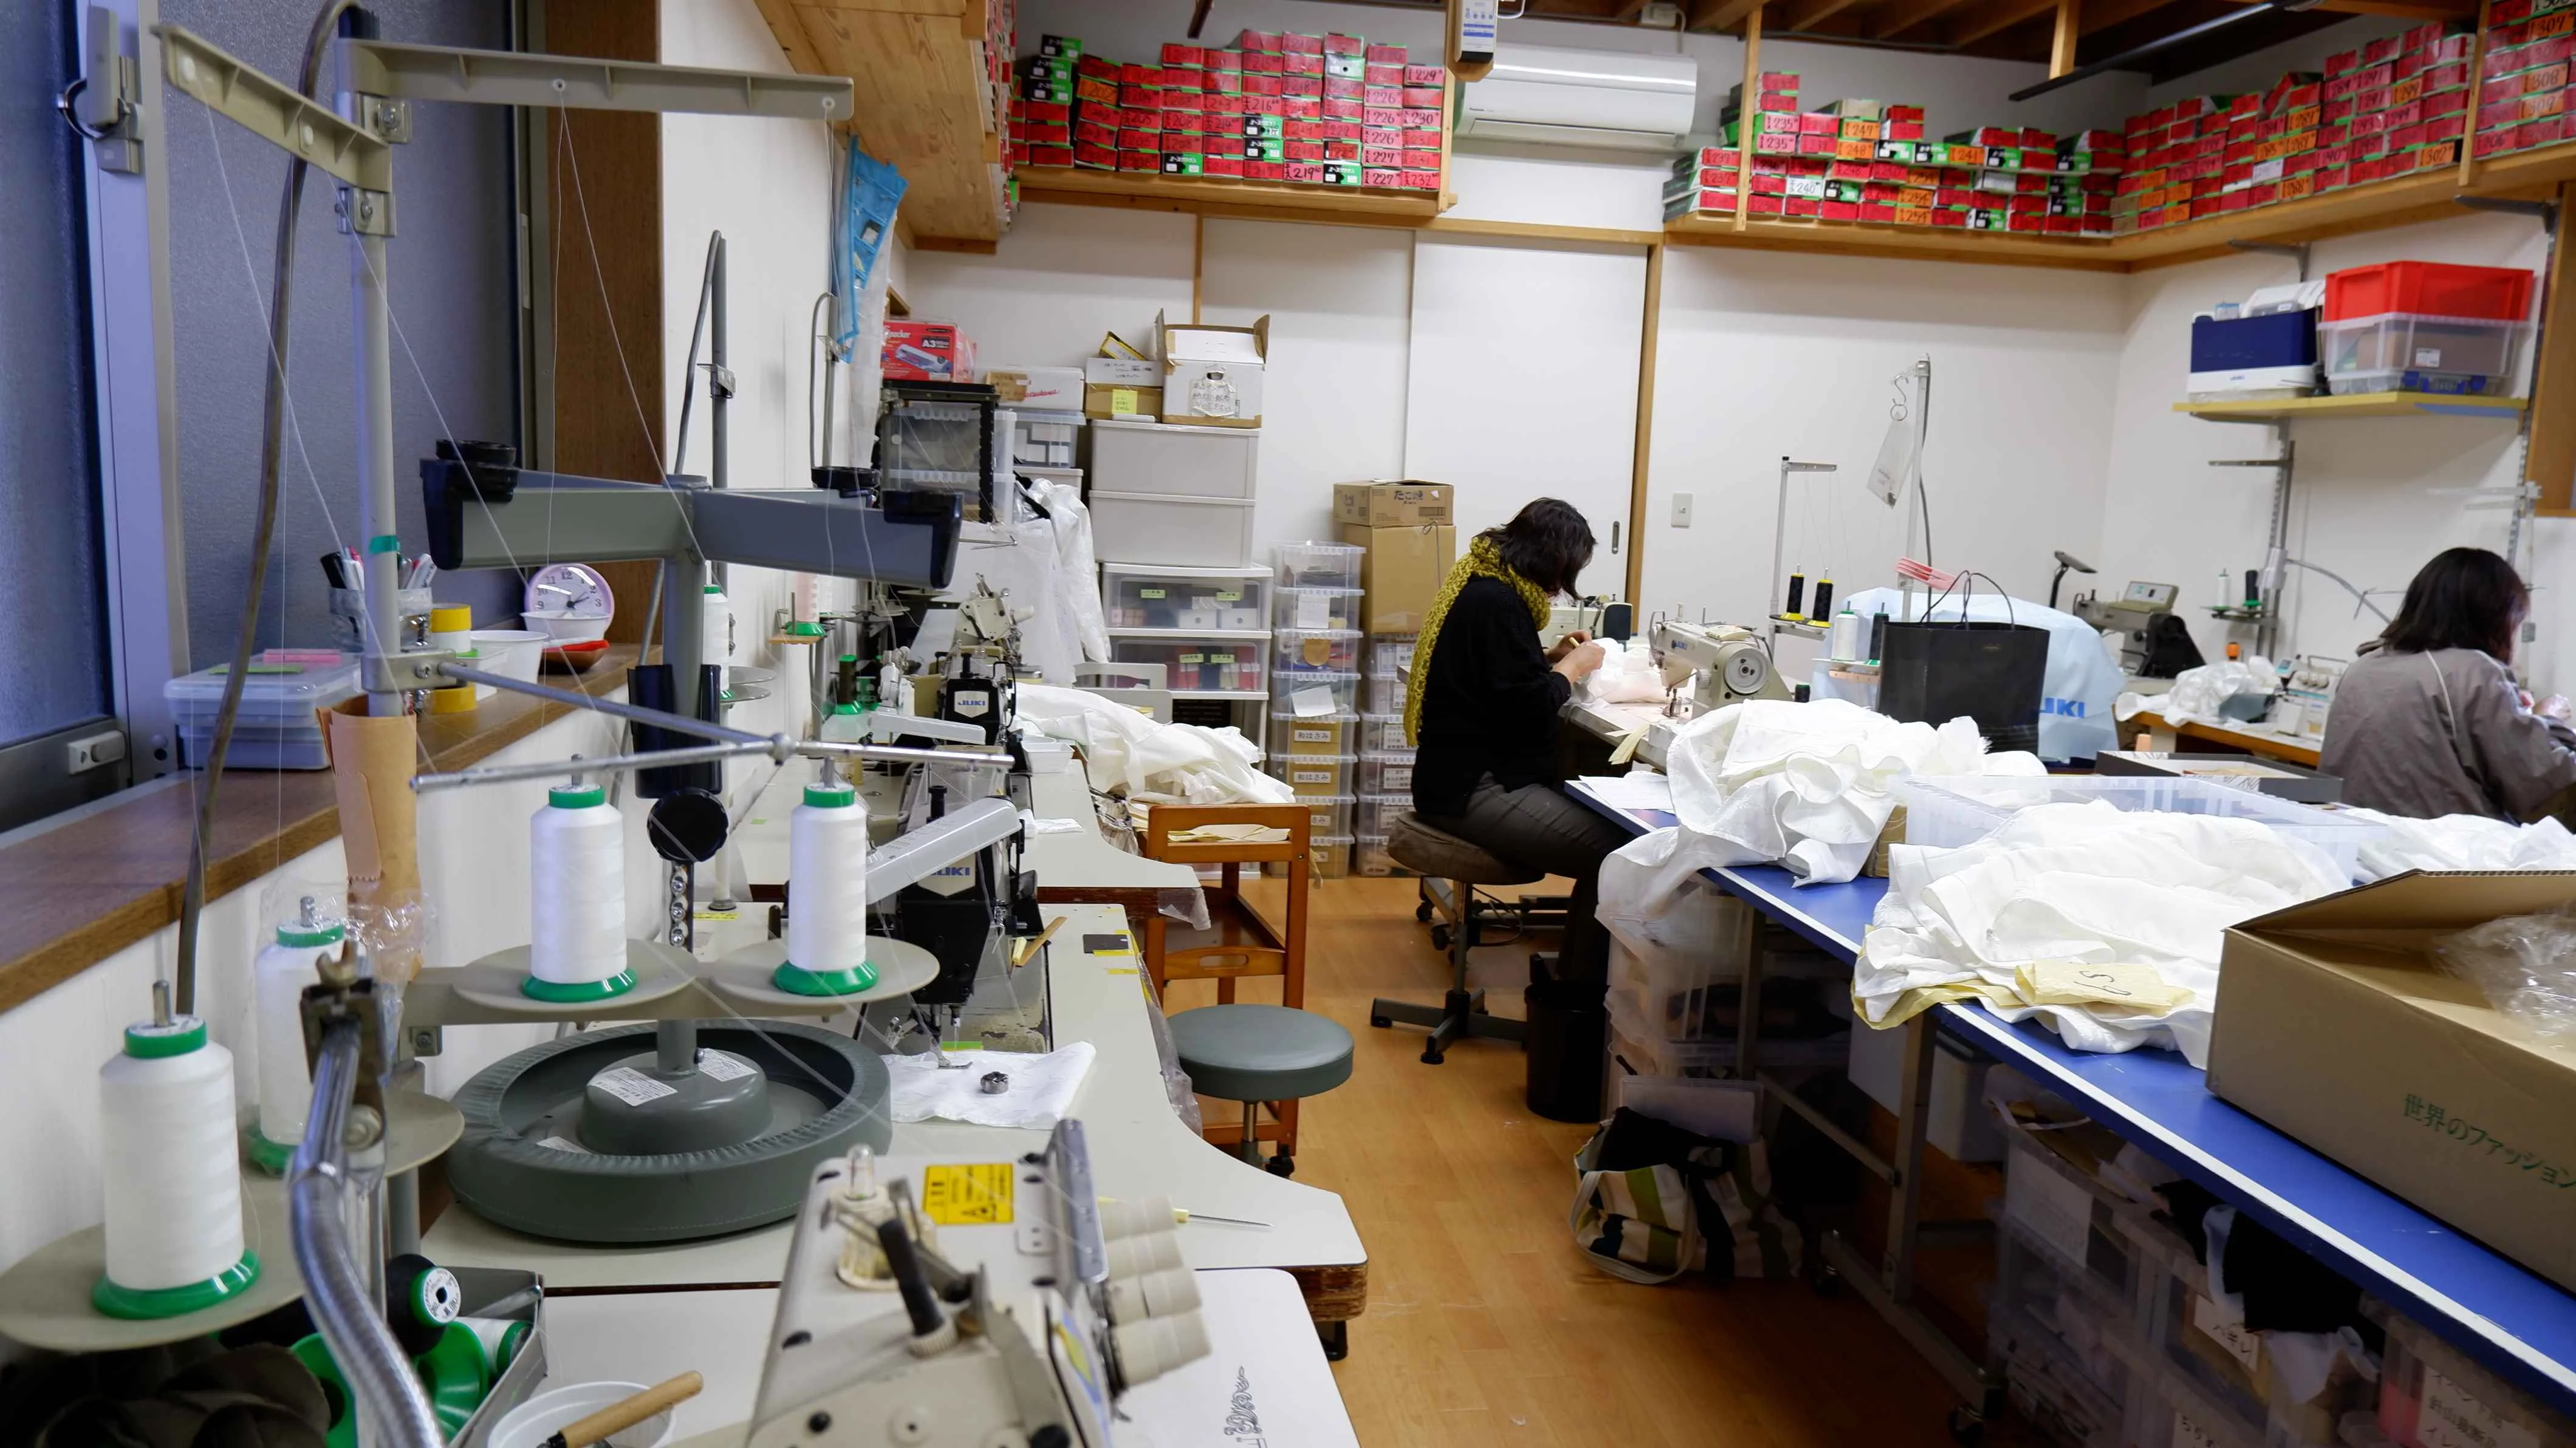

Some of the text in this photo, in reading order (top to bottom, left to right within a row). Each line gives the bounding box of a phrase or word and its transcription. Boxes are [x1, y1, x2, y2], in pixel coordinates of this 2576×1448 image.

[2537, 16, 2565, 37] 307
[1416, 69, 1436, 81] 229
[2533, 69, 2559, 89] 308
[1252, 97, 1272, 111] 216
[1374, 91, 1396, 105] 226
[2529, 95, 2554, 117] 309
[1374, 112, 1395, 124] 226
[1372, 132, 1394, 145] 226
[1766, 136, 1788, 149] 235
[1373, 151, 1394, 164] 227
[2426, 146, 2447, 164] 302
[1293, 167, 1314, 179] 219
[1372, 172, 1394, 185] 227
[1411, 173, 1431, 186] 232
[1796, 183, 1817, 195] 240
[2040, 697, 2085, 719] UKI
[2403, 1093, 2576, 1189] 世界のファッション
